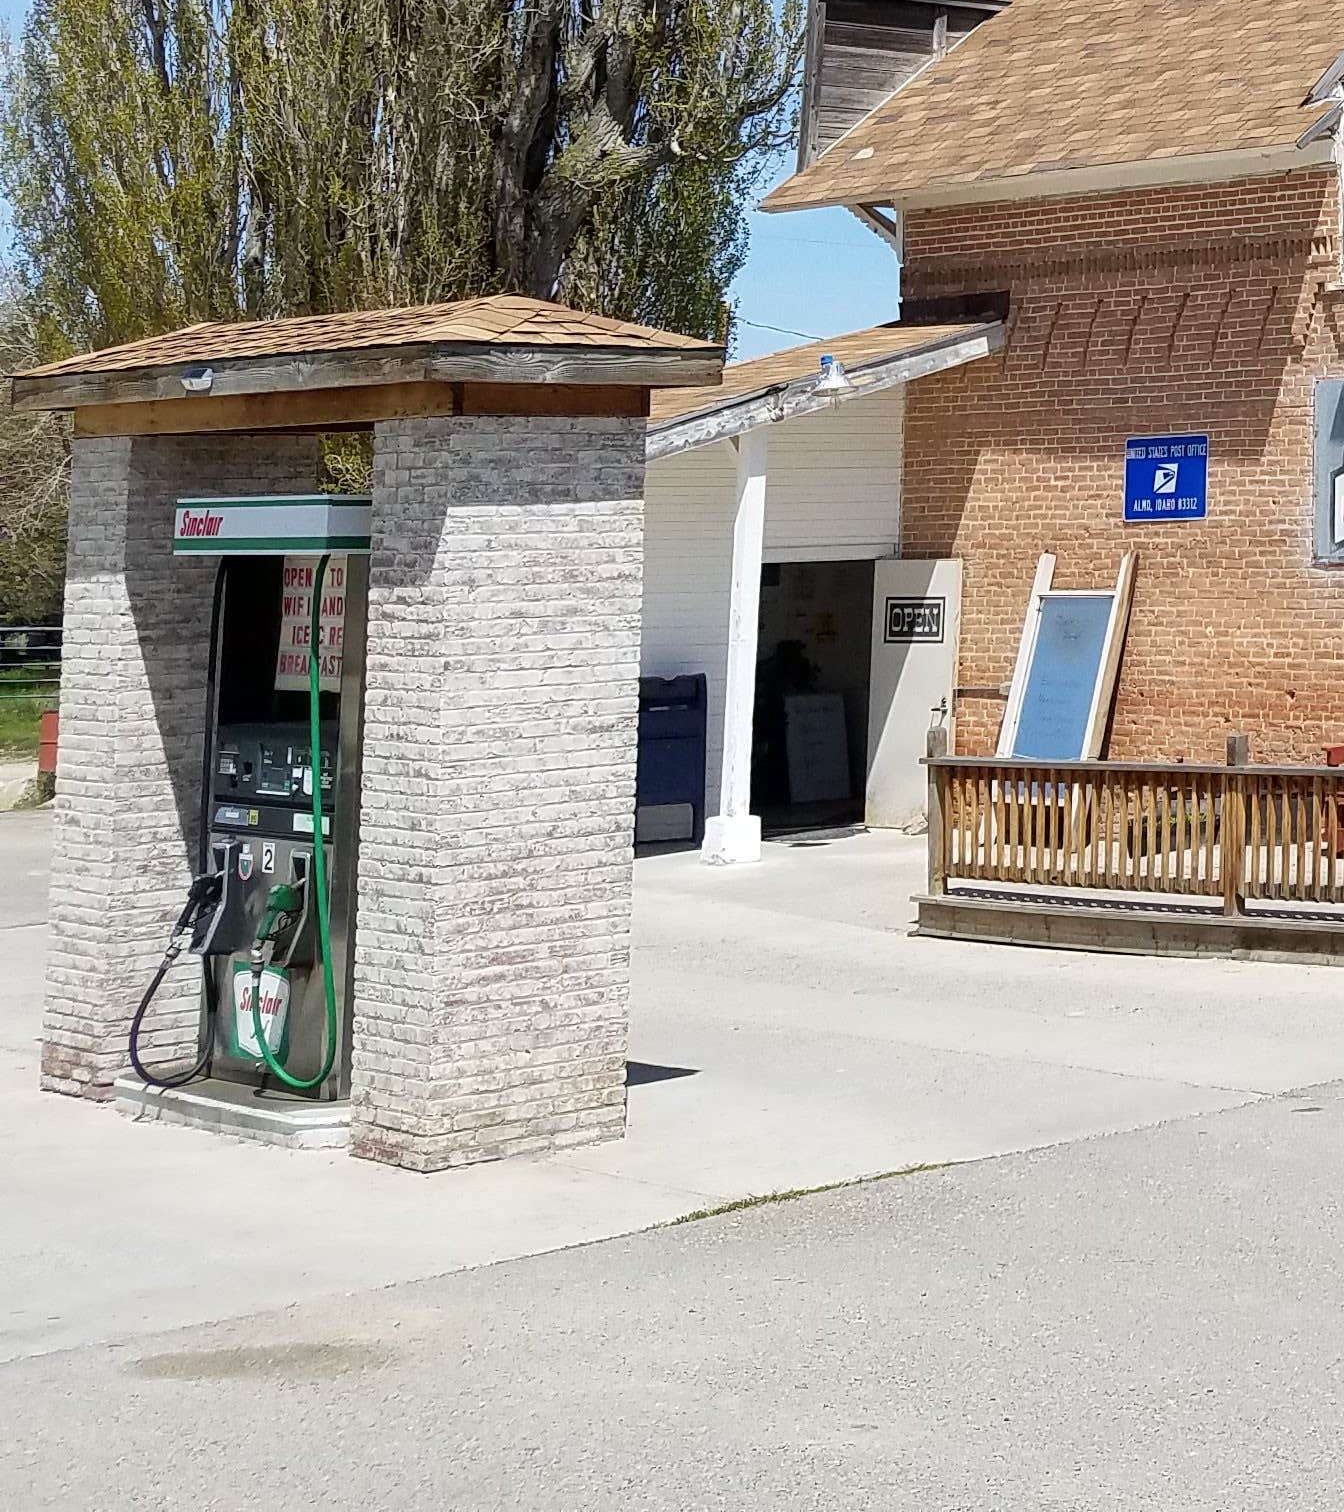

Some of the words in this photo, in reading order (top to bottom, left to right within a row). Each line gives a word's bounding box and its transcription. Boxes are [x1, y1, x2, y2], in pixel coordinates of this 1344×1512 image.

[1127, 447, 1146, 460] ITED
[1148, 446, 1168, 458] STATES
[1170, 445, 1185, 457] POST
[1187, 444, 1206, 456] OFFICE
[1155, 498, 1176, 511] IDAHO
[179, 509, 224, 537] Sinclair
[284, 568, 313, 588] OPEN
[329, 568, 344, 588] TO
[321, 596, 344, 617] AND
[891, 607, 939, 633] OPEN
[292, 626, 311, 646] ICE
[280, 653, 344, 675] BREAAST
[264, 848, 273, 871] 2
